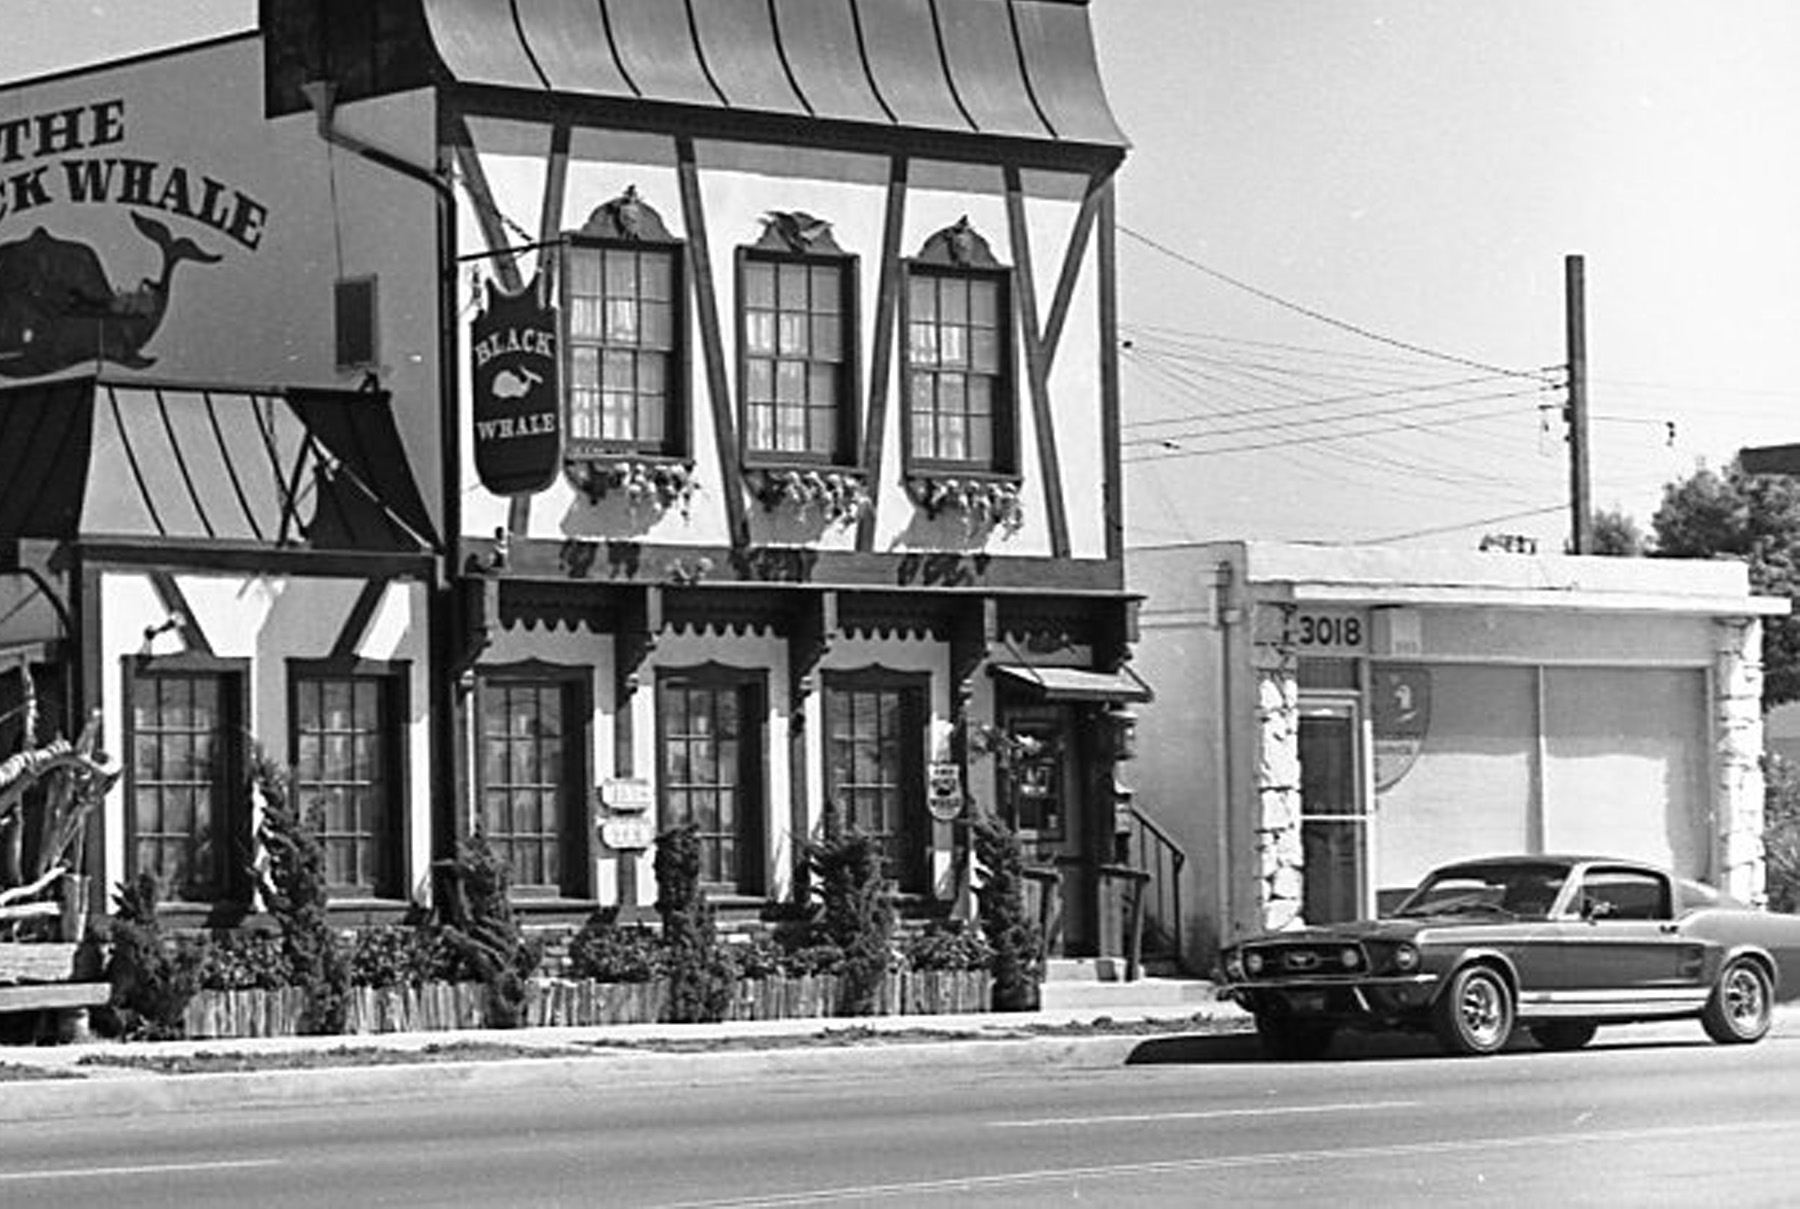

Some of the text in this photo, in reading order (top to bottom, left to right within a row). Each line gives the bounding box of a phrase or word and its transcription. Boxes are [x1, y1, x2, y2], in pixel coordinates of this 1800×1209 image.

[61, 158, 268, 251] WHALE
[475, 328, 554, 366] BLACK
[476, 413, 555, 440] WHALE
[1299, 616, 1361, 645] 3018
